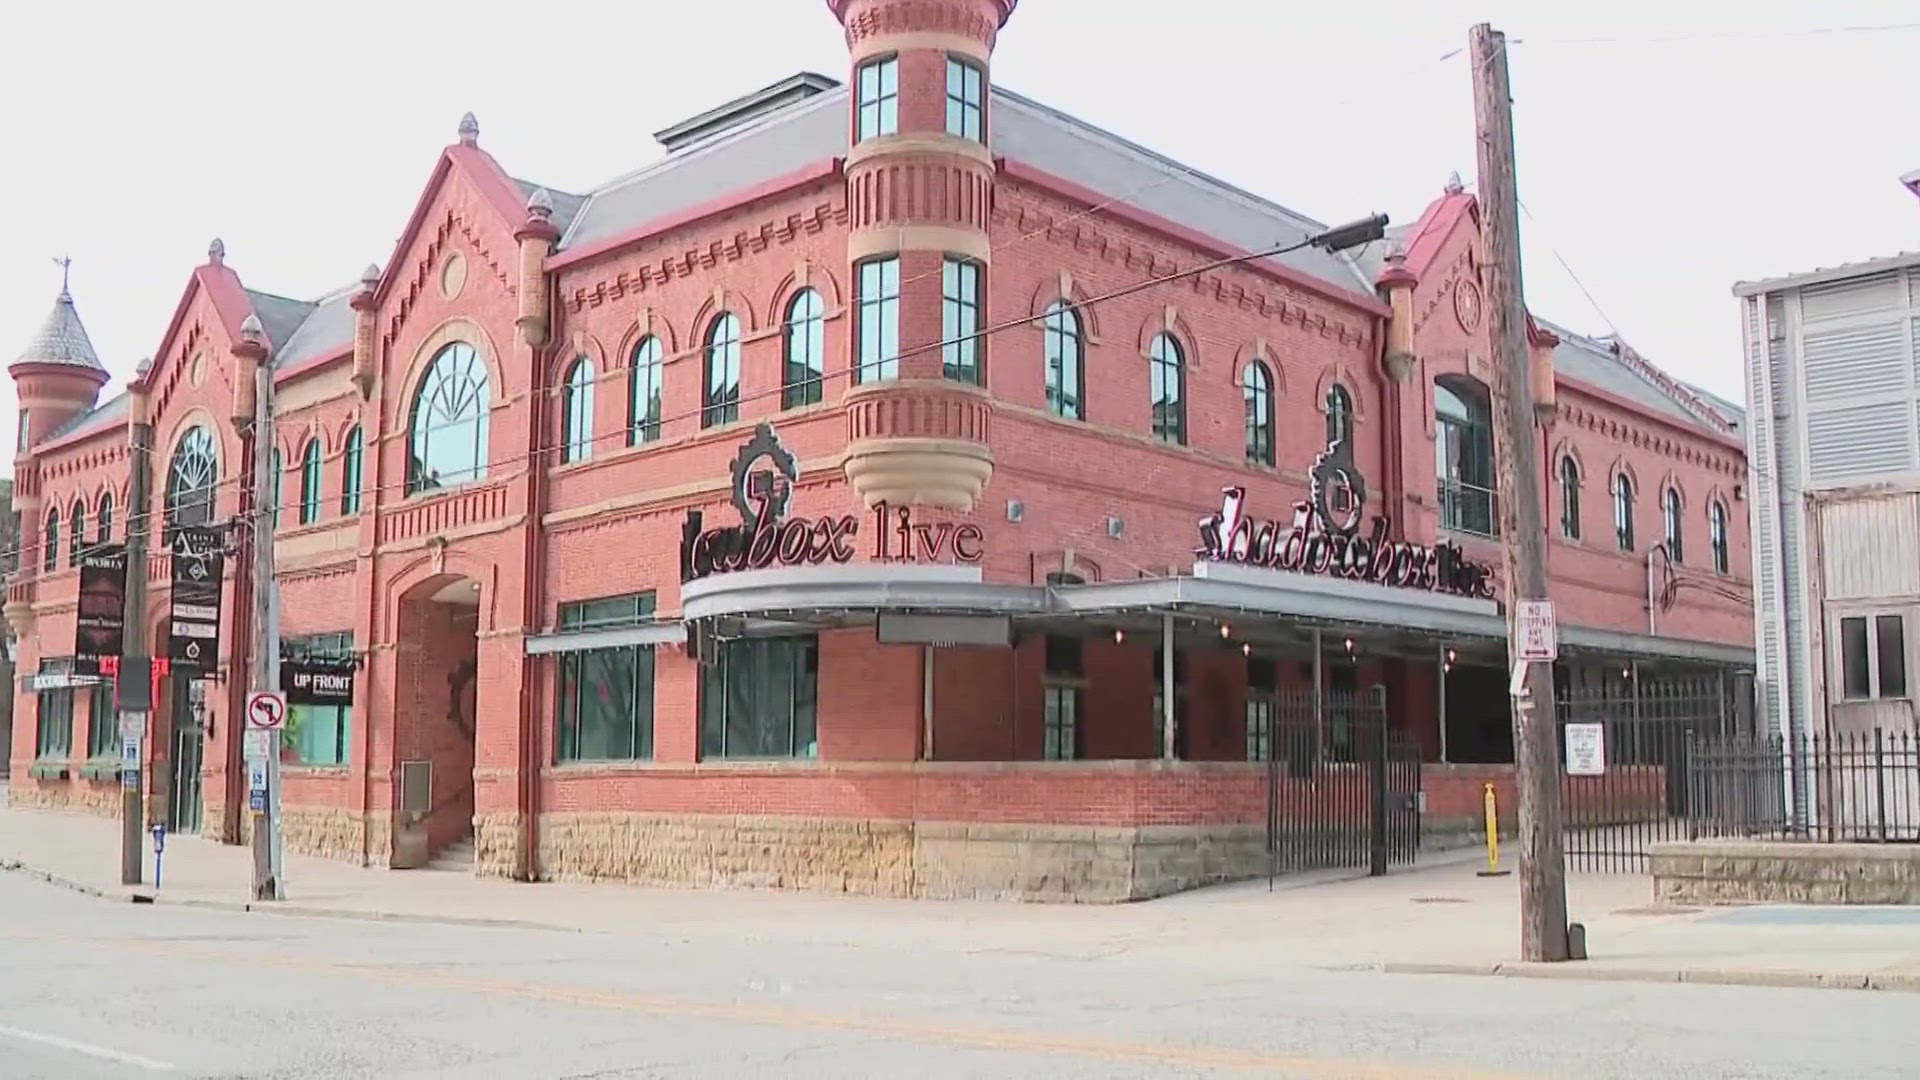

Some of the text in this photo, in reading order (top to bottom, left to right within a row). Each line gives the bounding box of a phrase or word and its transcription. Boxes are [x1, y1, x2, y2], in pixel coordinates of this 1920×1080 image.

[870, 499, 984, 563] live
[1528, 605, 1541, 616] NO
[294, 672, 352, 689] UP FRONT
